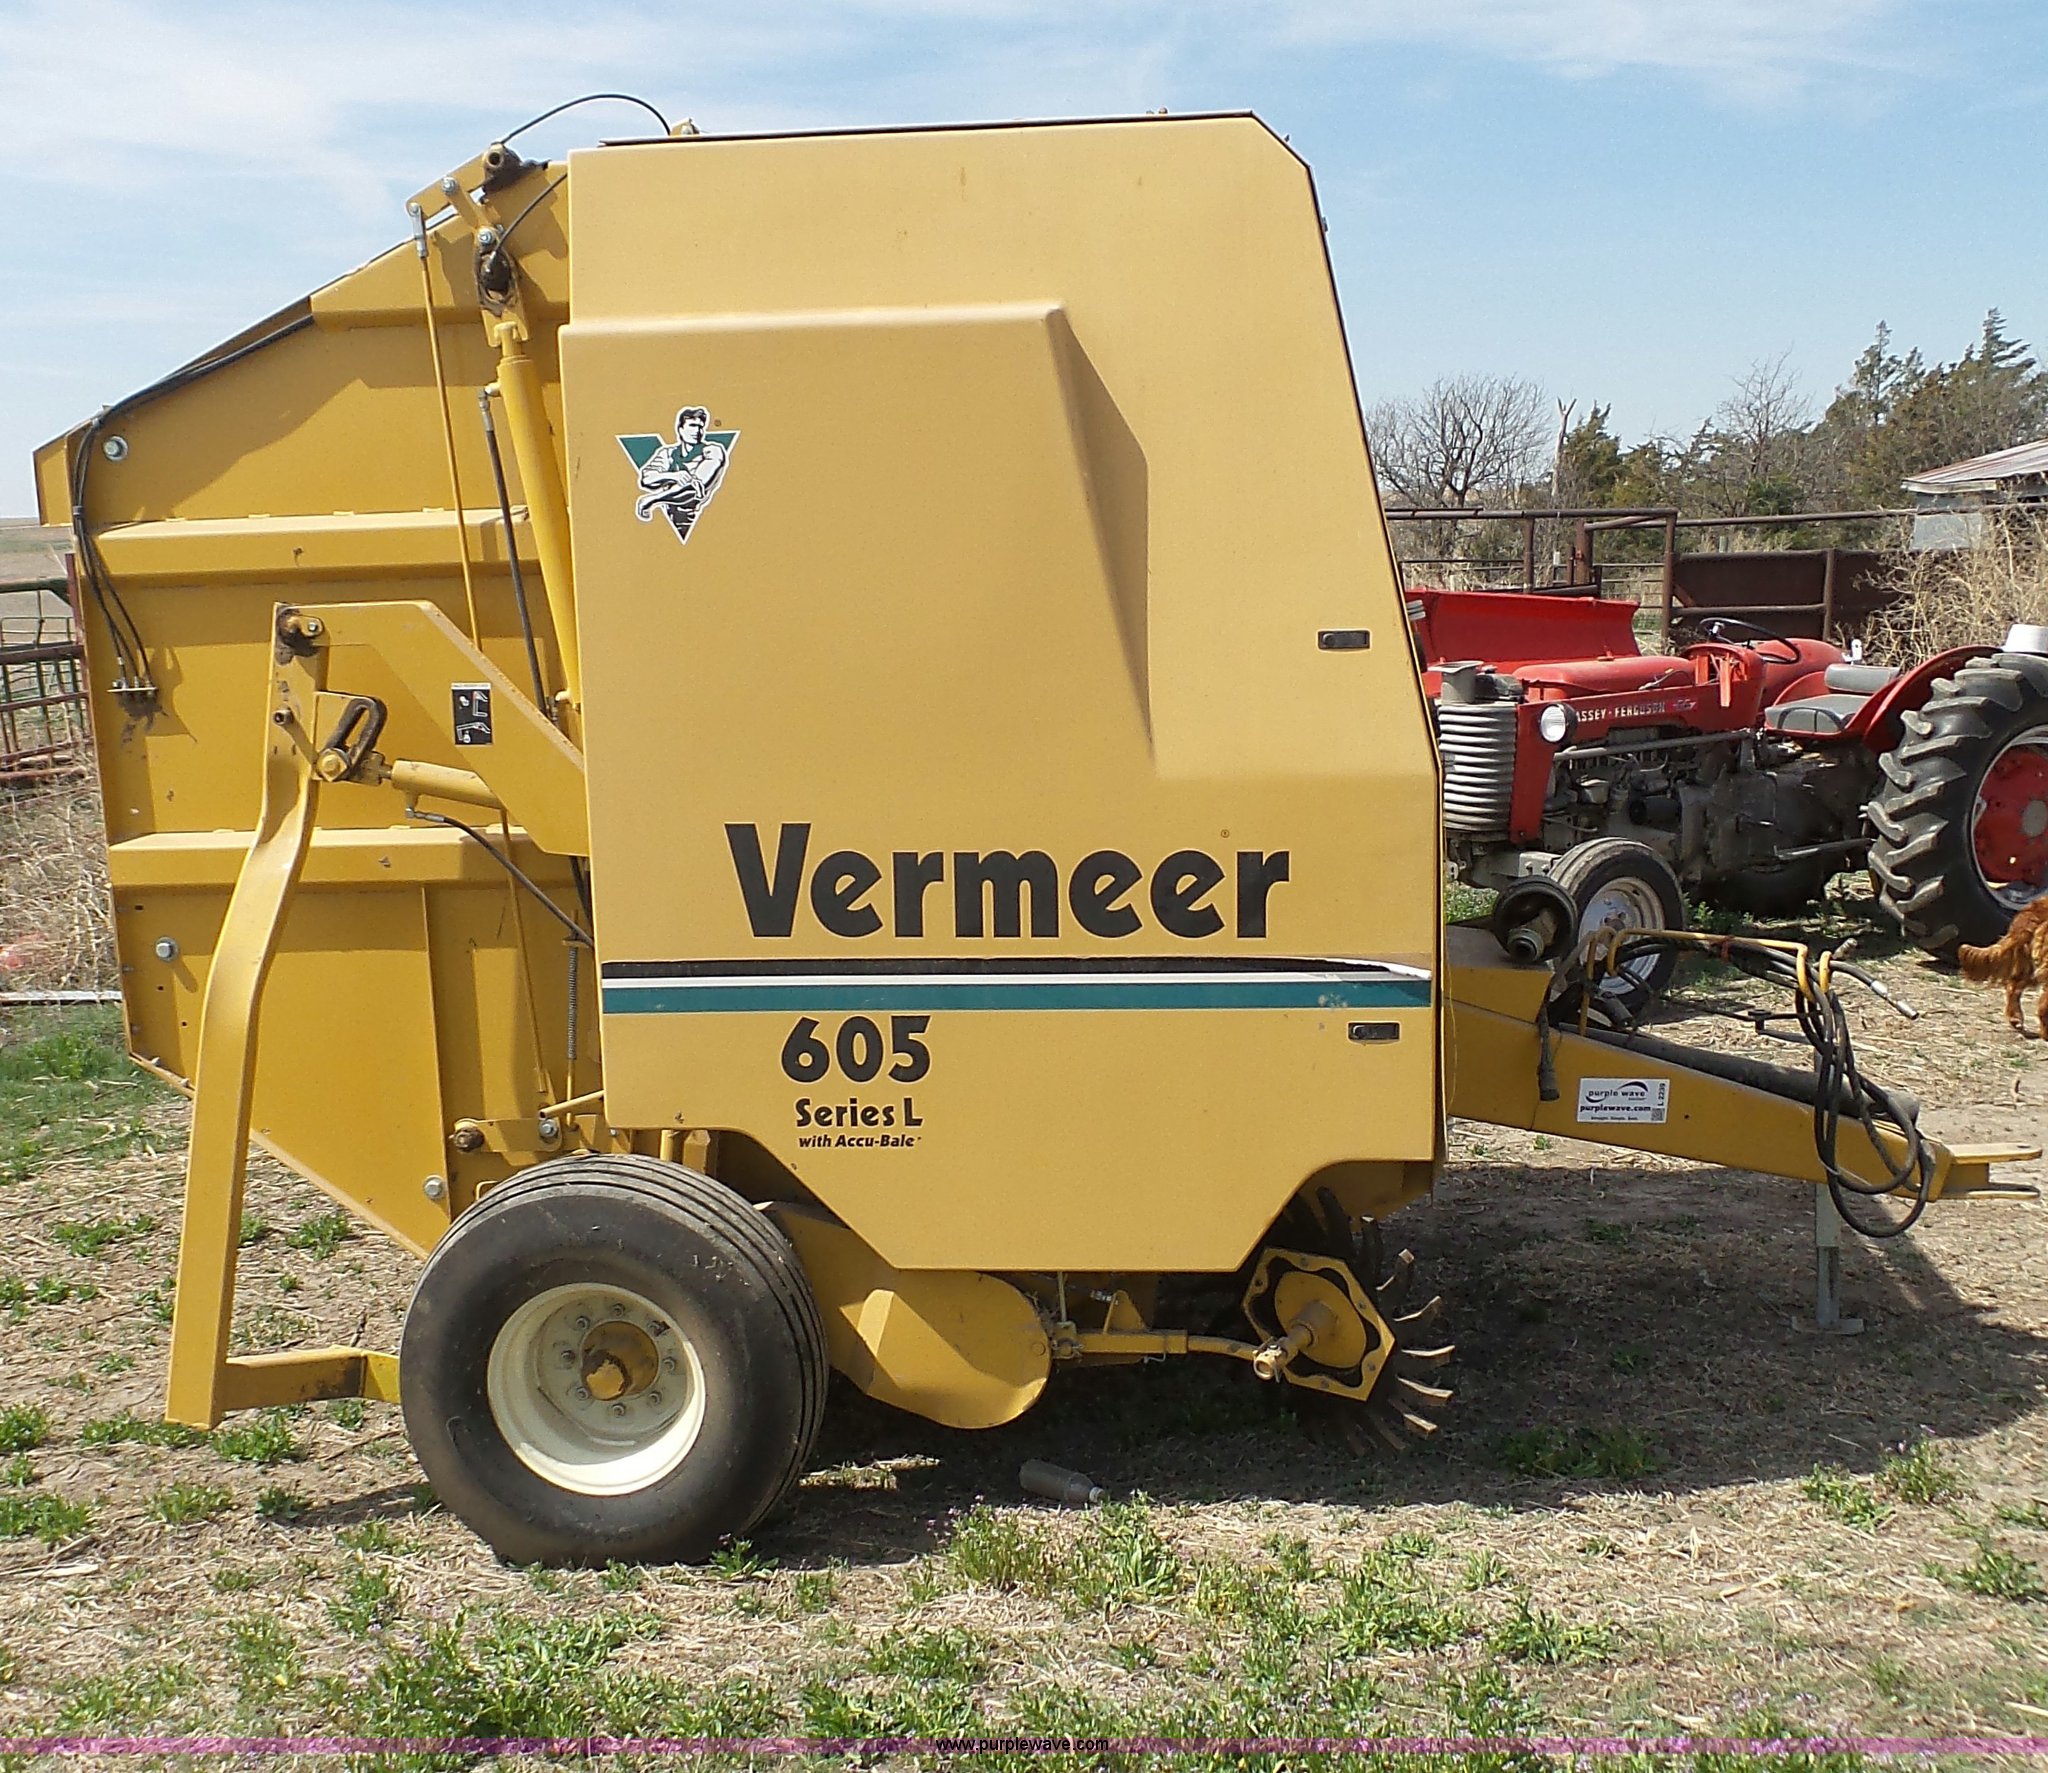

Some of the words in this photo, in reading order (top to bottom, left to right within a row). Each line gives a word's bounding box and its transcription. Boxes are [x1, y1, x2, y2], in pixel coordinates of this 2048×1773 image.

[1575, 708, 1607, 723] ASSEY
[724, 822, 1290, 938] Vermeer
[780, 1015, 932, 1083] 605
[1588, 1089, 1619, 1098] purple
[795, 1097, 895, 1127] Series
[903, 1097, 924, 1127] L
[1580, 1104, 1651, 1113] purplewave.com
[798, 1135, 832, 1148] with
[834, 1134, 916, 1148] Accu-Bale
